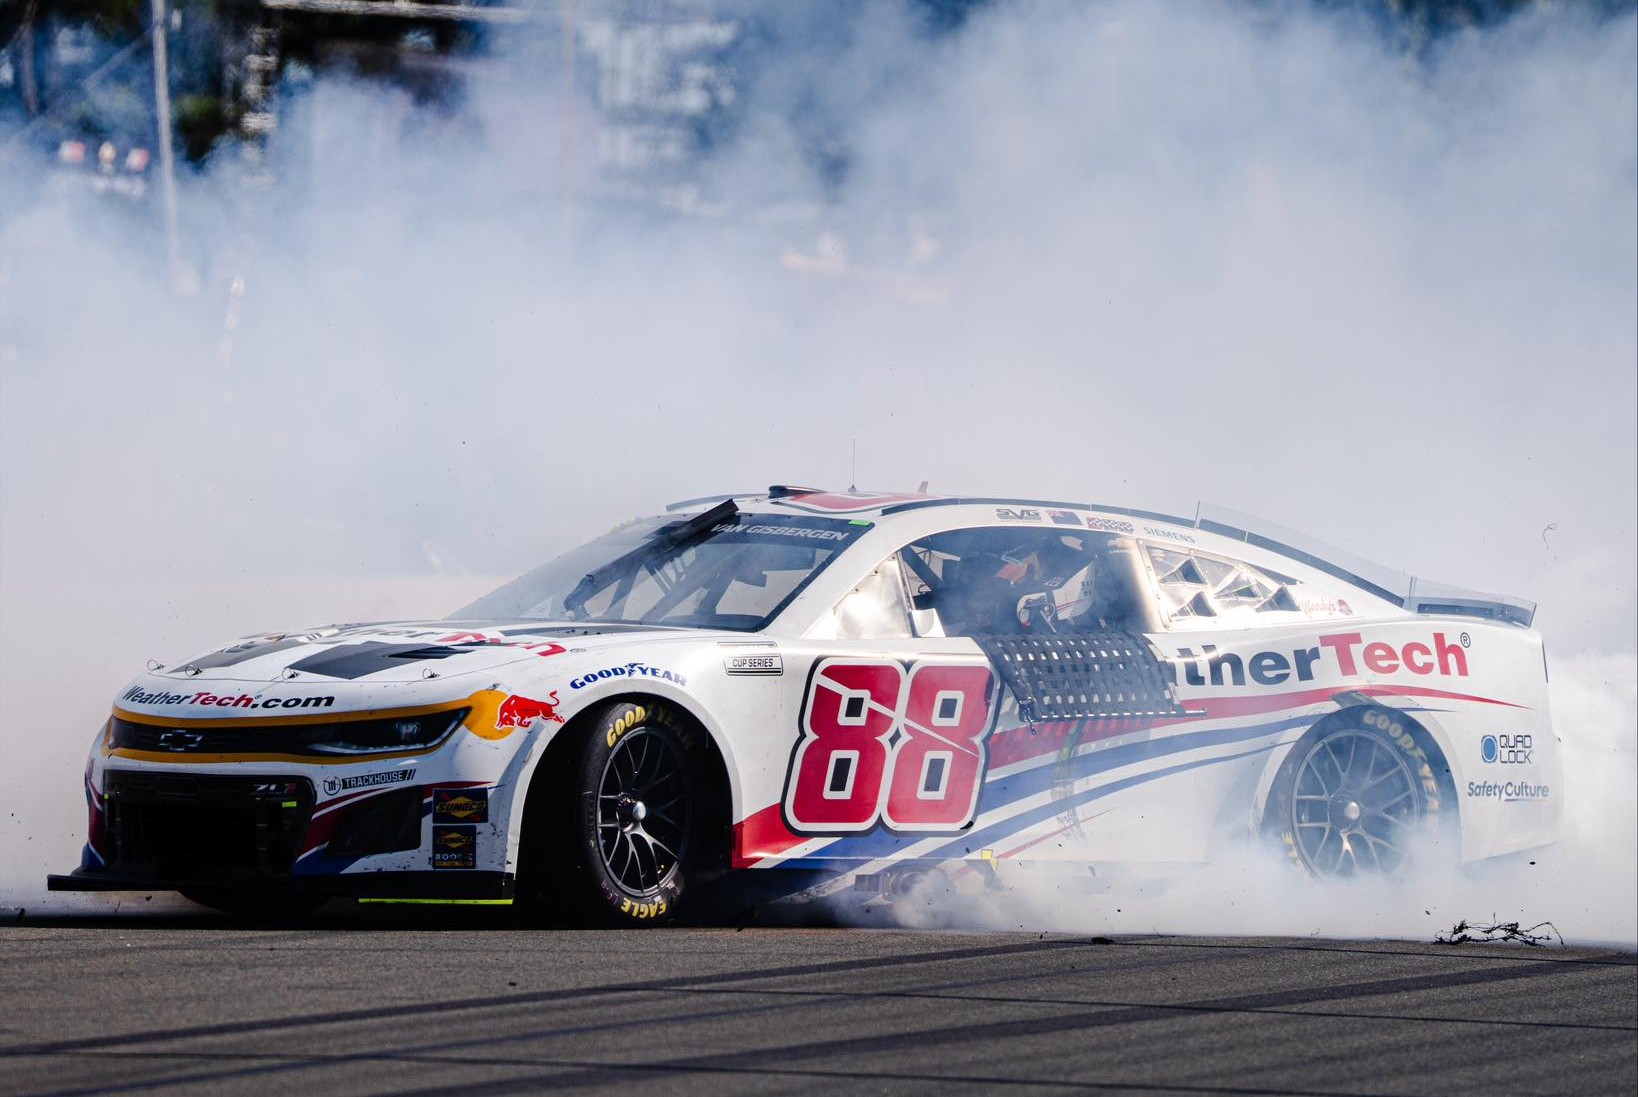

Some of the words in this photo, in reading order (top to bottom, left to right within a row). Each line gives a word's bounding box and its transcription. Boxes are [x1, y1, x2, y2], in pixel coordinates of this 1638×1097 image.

[710, 523, 746, 533] VAN
[746, 525, 849, 541] GISBERGEN
[1144, 526, 1196, 544] SIEMENS
[732, 658, 747, 668] CUP
[748, 658, 774, 668] SERIES
[570, 663, 688, 690] GOODYEAR
[782, 656, 1003, 838] 88
[1499, 734, 1532, 749] QUAD
[1499, 749, 1533, 764] LOCK
[344, 770, 404, 788] TRACKHOUSE
[1468, 781, 1550, 801] SafetyCulture
[436, 801, 485, 812] SUNOCO
[621, 897, 667, 918] EAGLE
